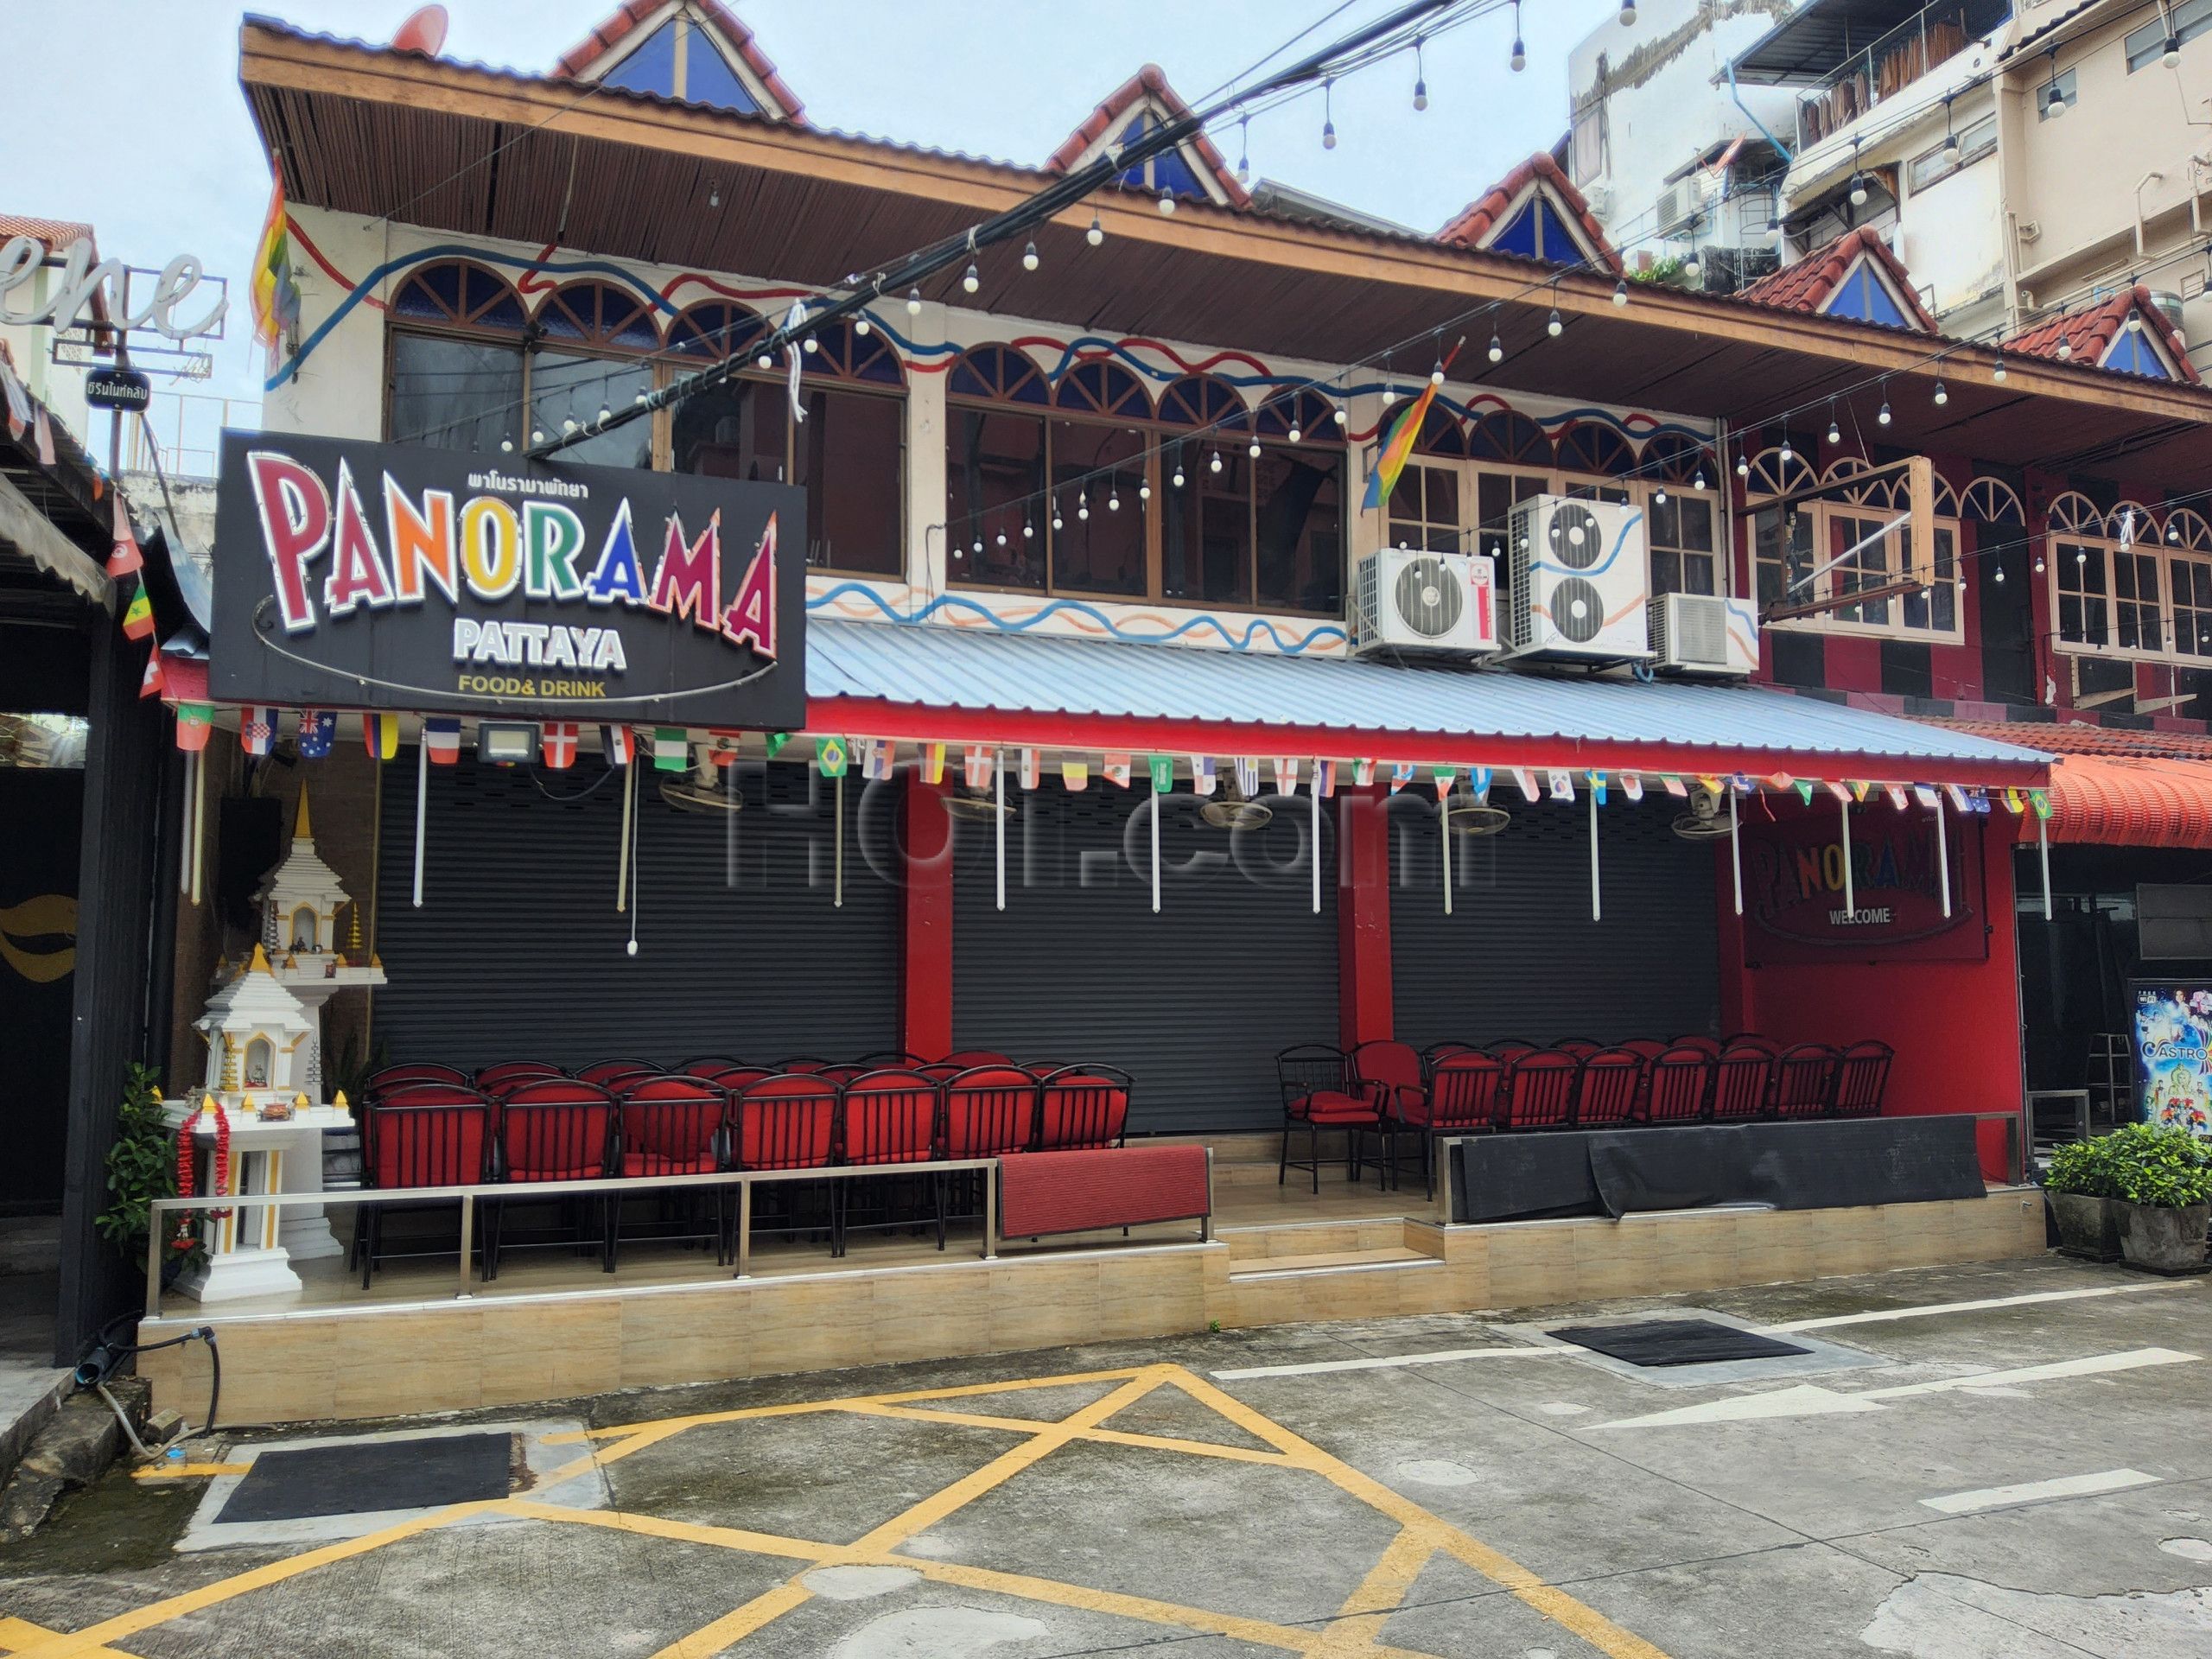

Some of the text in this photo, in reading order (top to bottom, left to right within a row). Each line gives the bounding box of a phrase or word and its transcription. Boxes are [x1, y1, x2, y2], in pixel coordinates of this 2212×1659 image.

[247, 450, 779, 659] PANORAMA
[453, 617, 627, 671] PATTAYA
[458, 674, 607, 697] FOOD& DRINK
[2142, 1040, 2209, 1060] CASTRO
